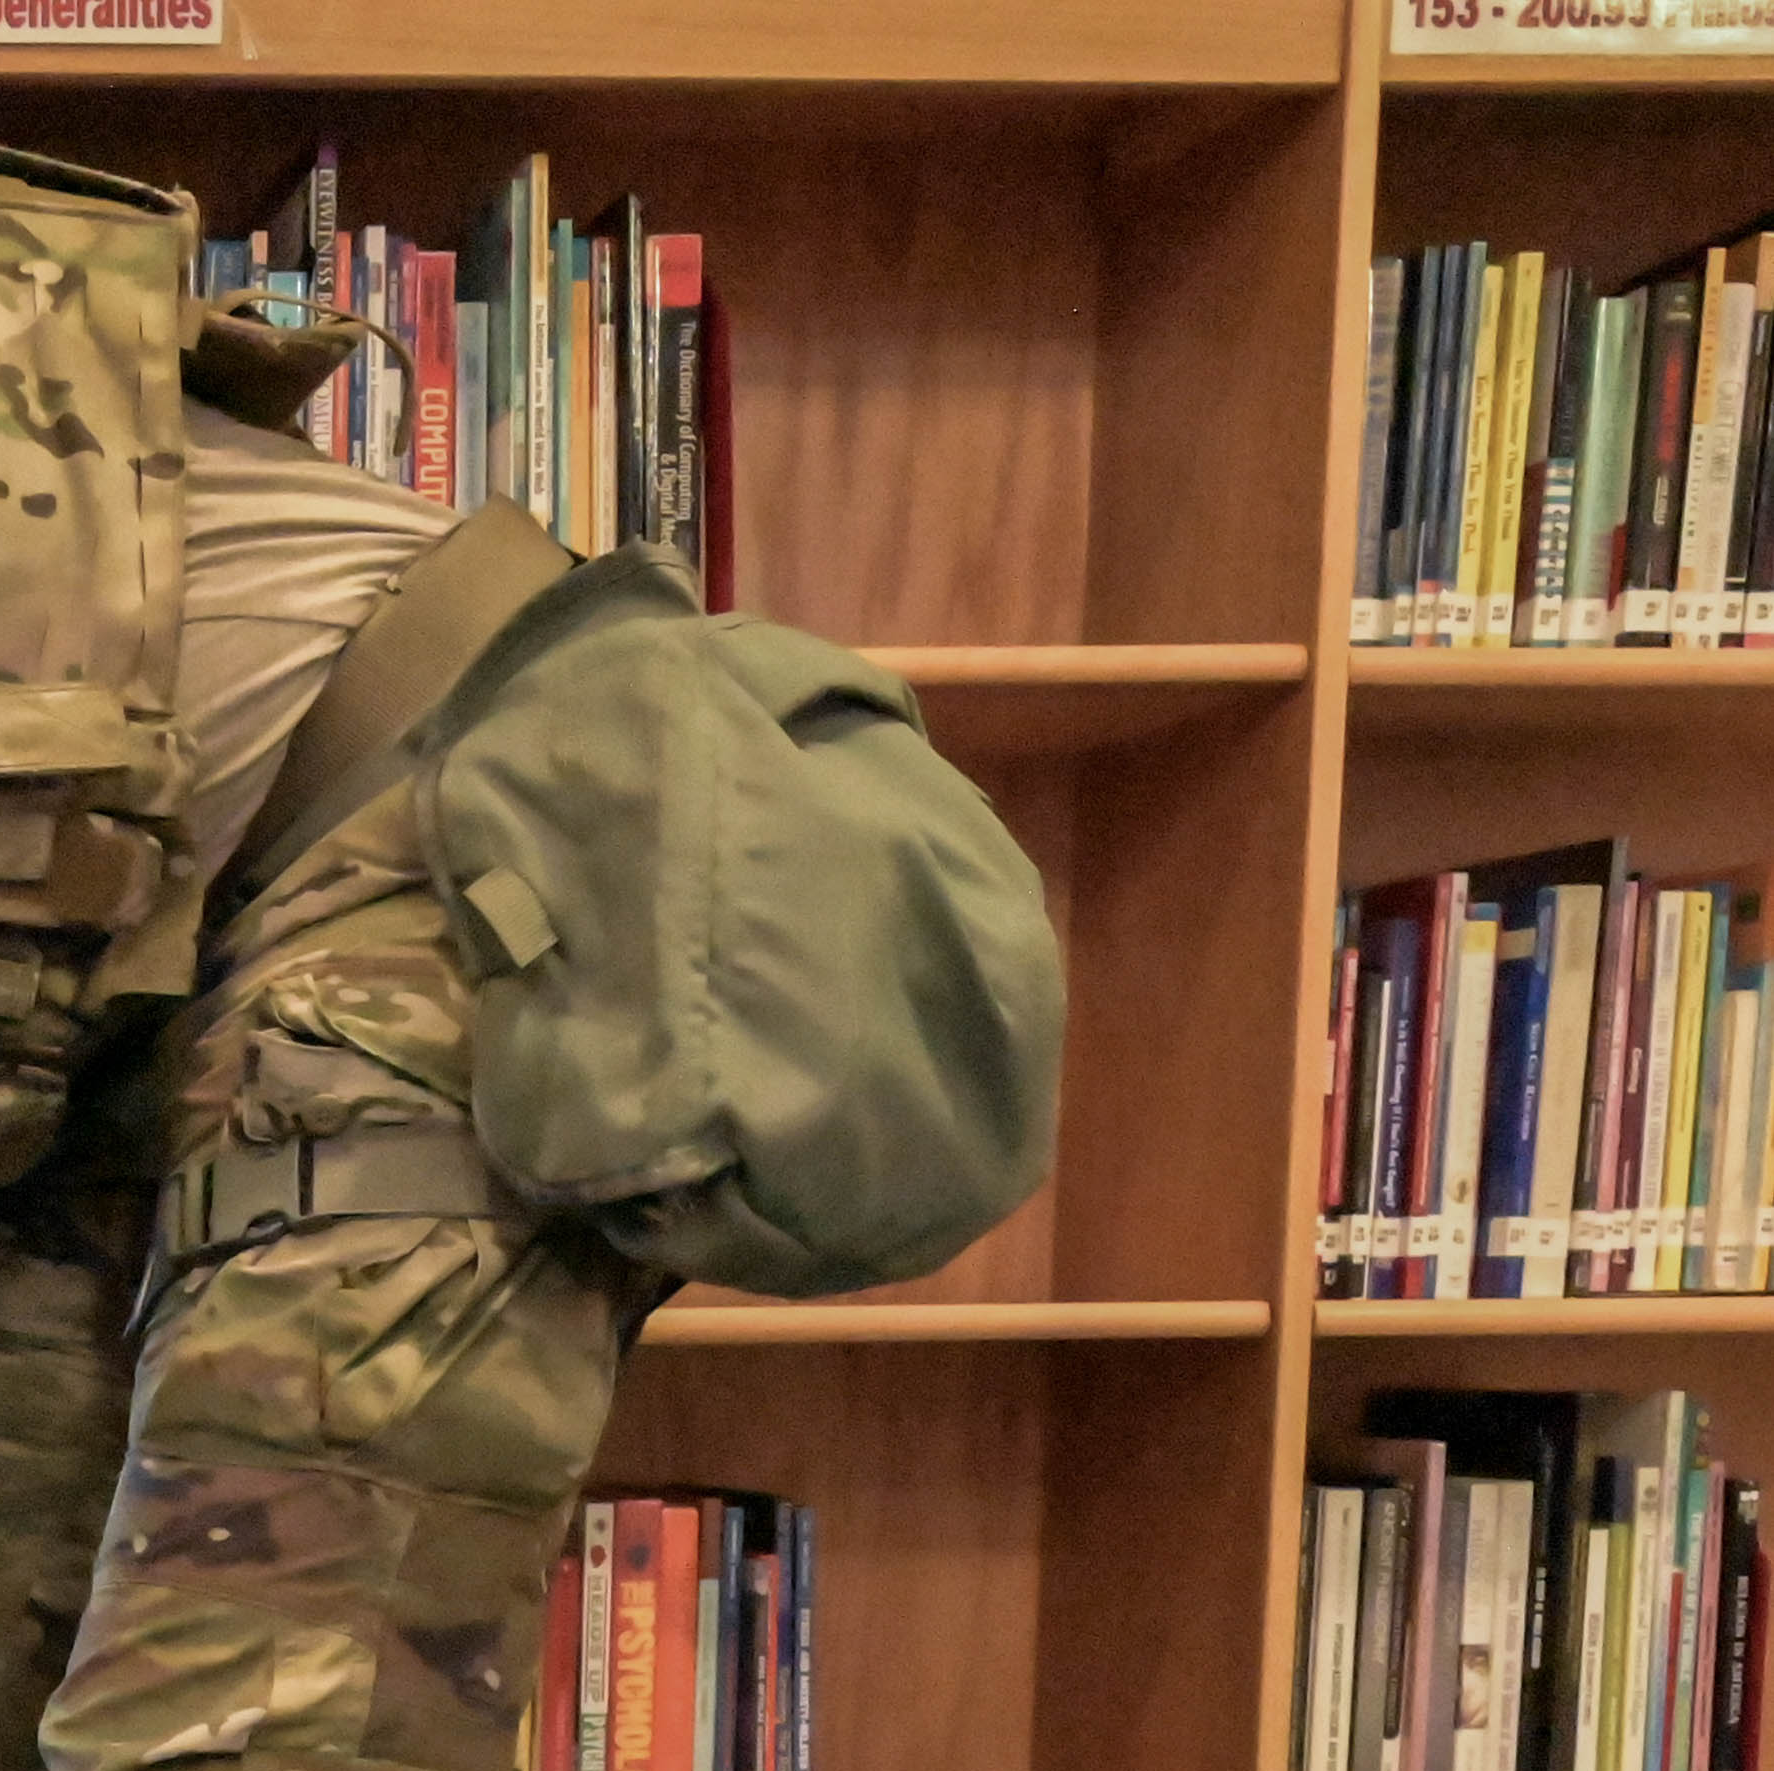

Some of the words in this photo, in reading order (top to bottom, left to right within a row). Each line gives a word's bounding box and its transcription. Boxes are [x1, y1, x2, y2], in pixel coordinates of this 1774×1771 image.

[1408, 0, 1481, 28] 153
[316, 168, 335, 284] EYEWITNESS
[679, 321, 696, 346] The
[674, 349, 696, 422] Dictionary
[678, 425, 695, 441] of
[655, 467, 677, 514] Digital
[671, 442, 695, 520] Computing
